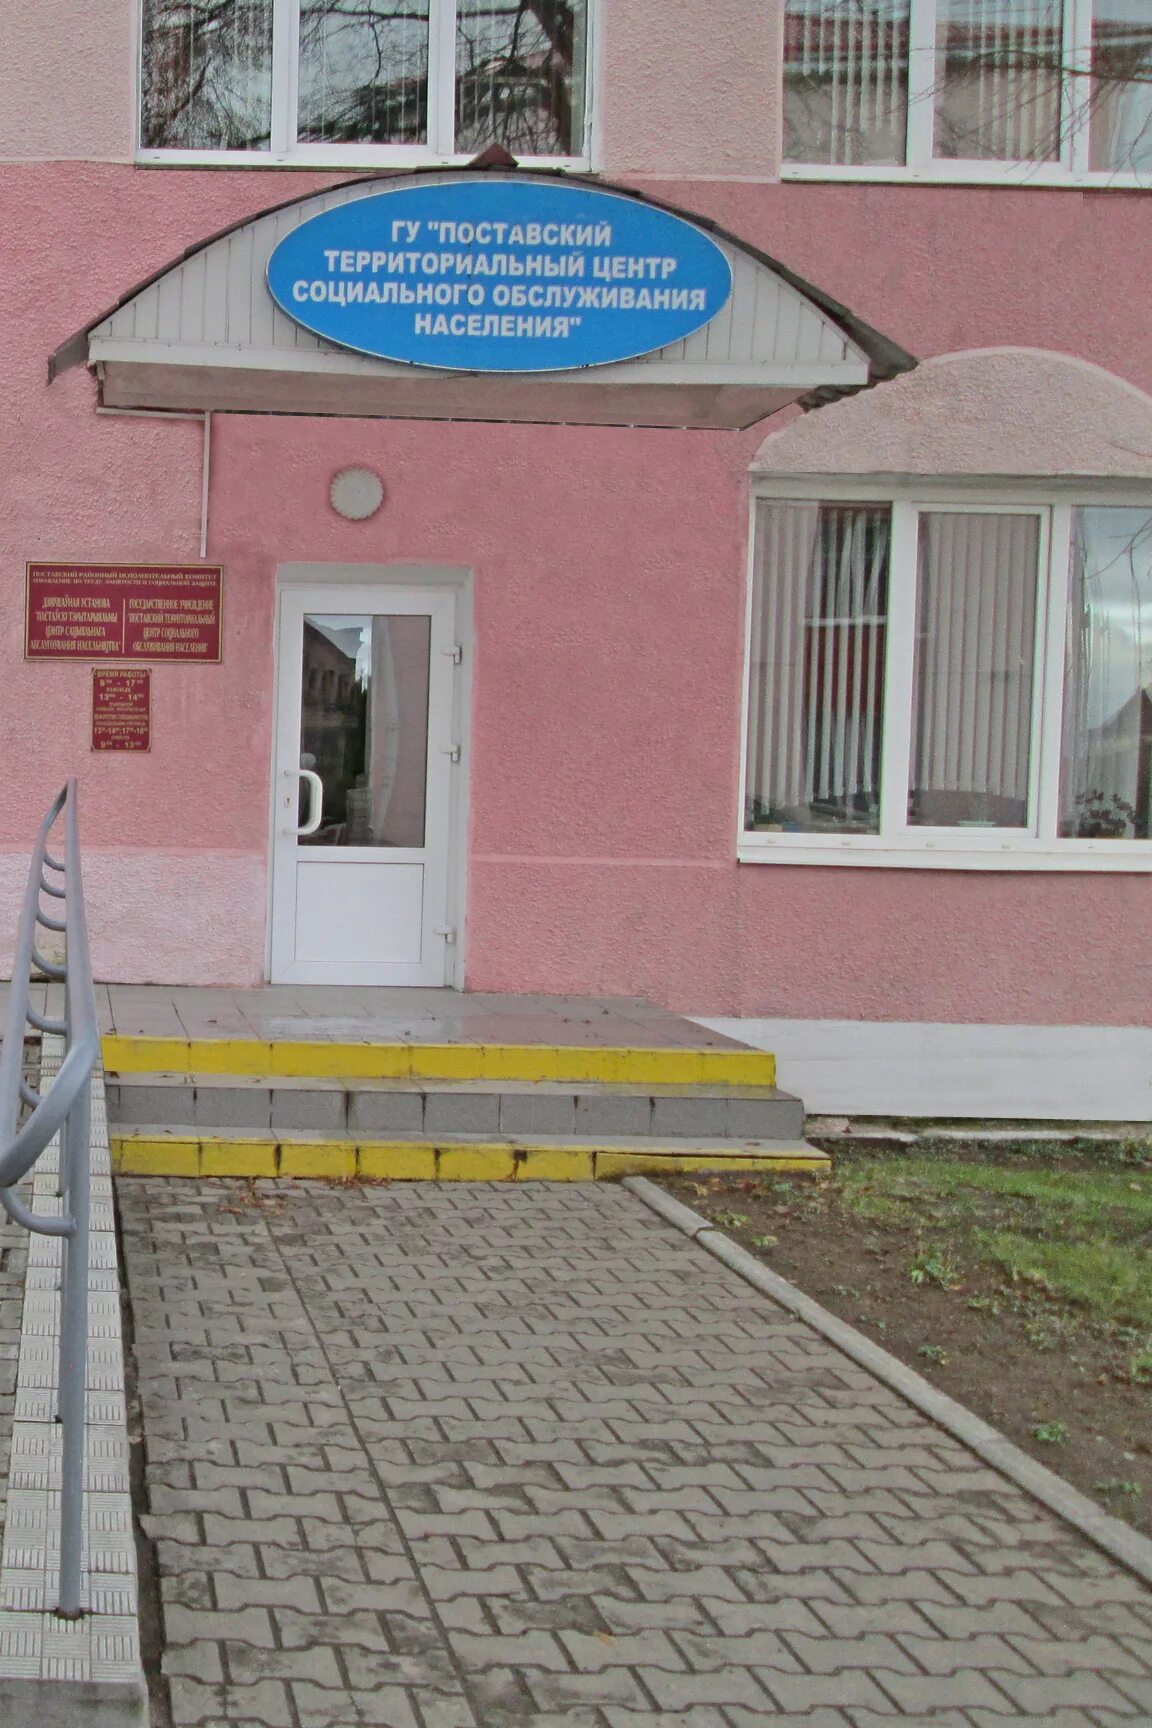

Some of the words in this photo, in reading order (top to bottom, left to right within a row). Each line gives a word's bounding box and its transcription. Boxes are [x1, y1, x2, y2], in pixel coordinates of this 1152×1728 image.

[391, 220, 421, 243] ГУ
[427, 220, 612, 247] "ПОСТАВСКИЙ
[324, 250, 585, 278] ТЕРРИТОРИАЛЬНЫЙ
[592, 256, 677, 282] ЦЕНТР
[292, 280, 485, 307] СОЦИАЛЬНОГО
[492, 285, 706, 311] ОБСЛУЖИВАНИЯ
[414, 313, 581, 338] НАСЕЛЕНИЯ"
